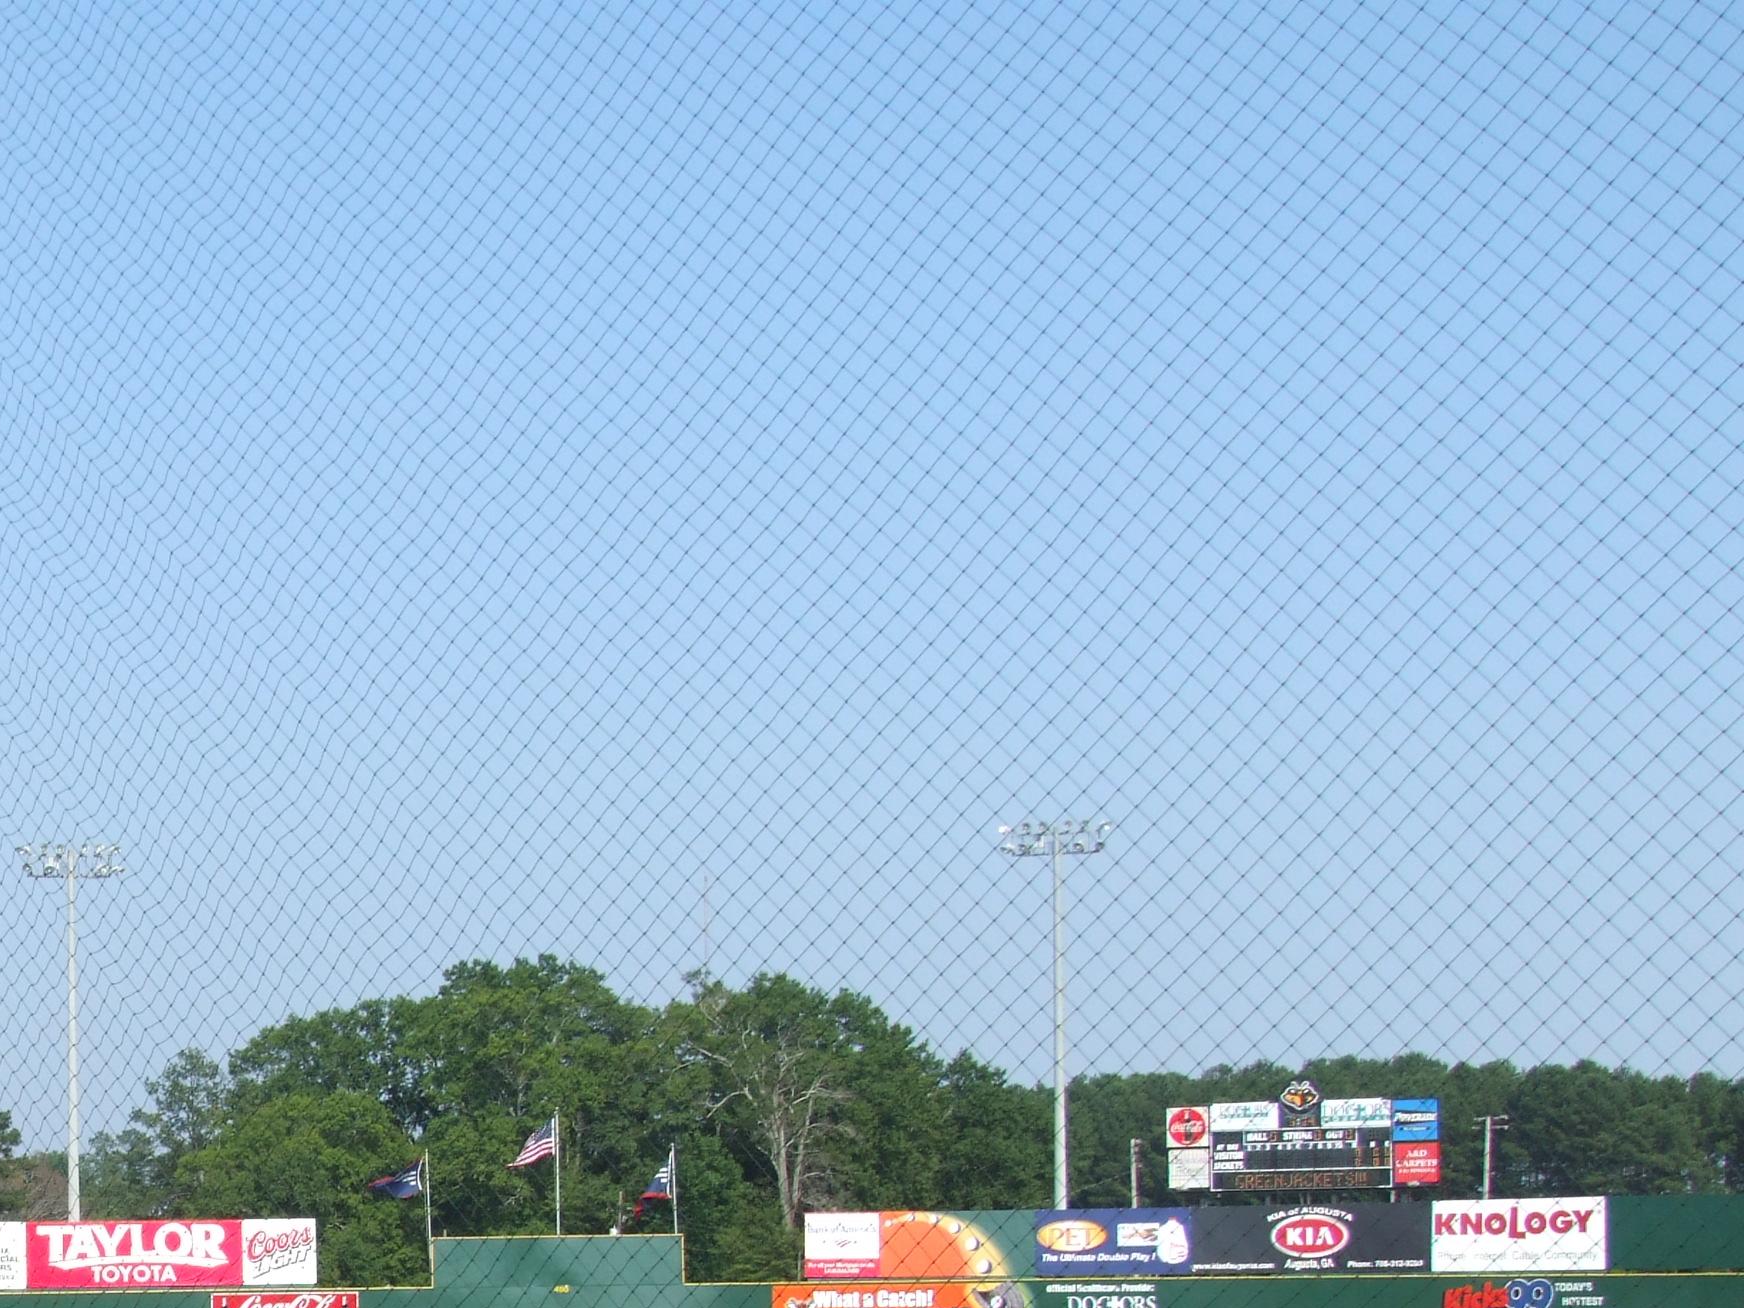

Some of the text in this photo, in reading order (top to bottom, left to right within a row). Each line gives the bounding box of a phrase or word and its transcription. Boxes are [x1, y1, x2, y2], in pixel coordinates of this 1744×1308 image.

[1267, 1212, 1286, 1222] KIA
[1300, 1207, 1353, 1222] AUGUSTA
[1434, 1206, 1594, 1239] KNOLOGY
[36, 1223, 230, 1260] TAYLOR
[247, 1225, 314, 1262] Coors
[1047, 1228, 1100, 1246] PET
[1286, 1227, 1334, 1246] KIA
[252, 1247, 311, 1279] LIGHT
[1042, 1254, 1058, 1262] The
[1097, 1253, 1130, 1262] Double
[1321, 1259, 1335, 1268] GA
[92, 1265, 177, 1283] TOYOTA
[1554, 1282, 1593, 1291] TODAY'S
[812, 1289, 934, 1308] What a Catch!
[1562, 1296, 1603, 1306] HOTTEST
